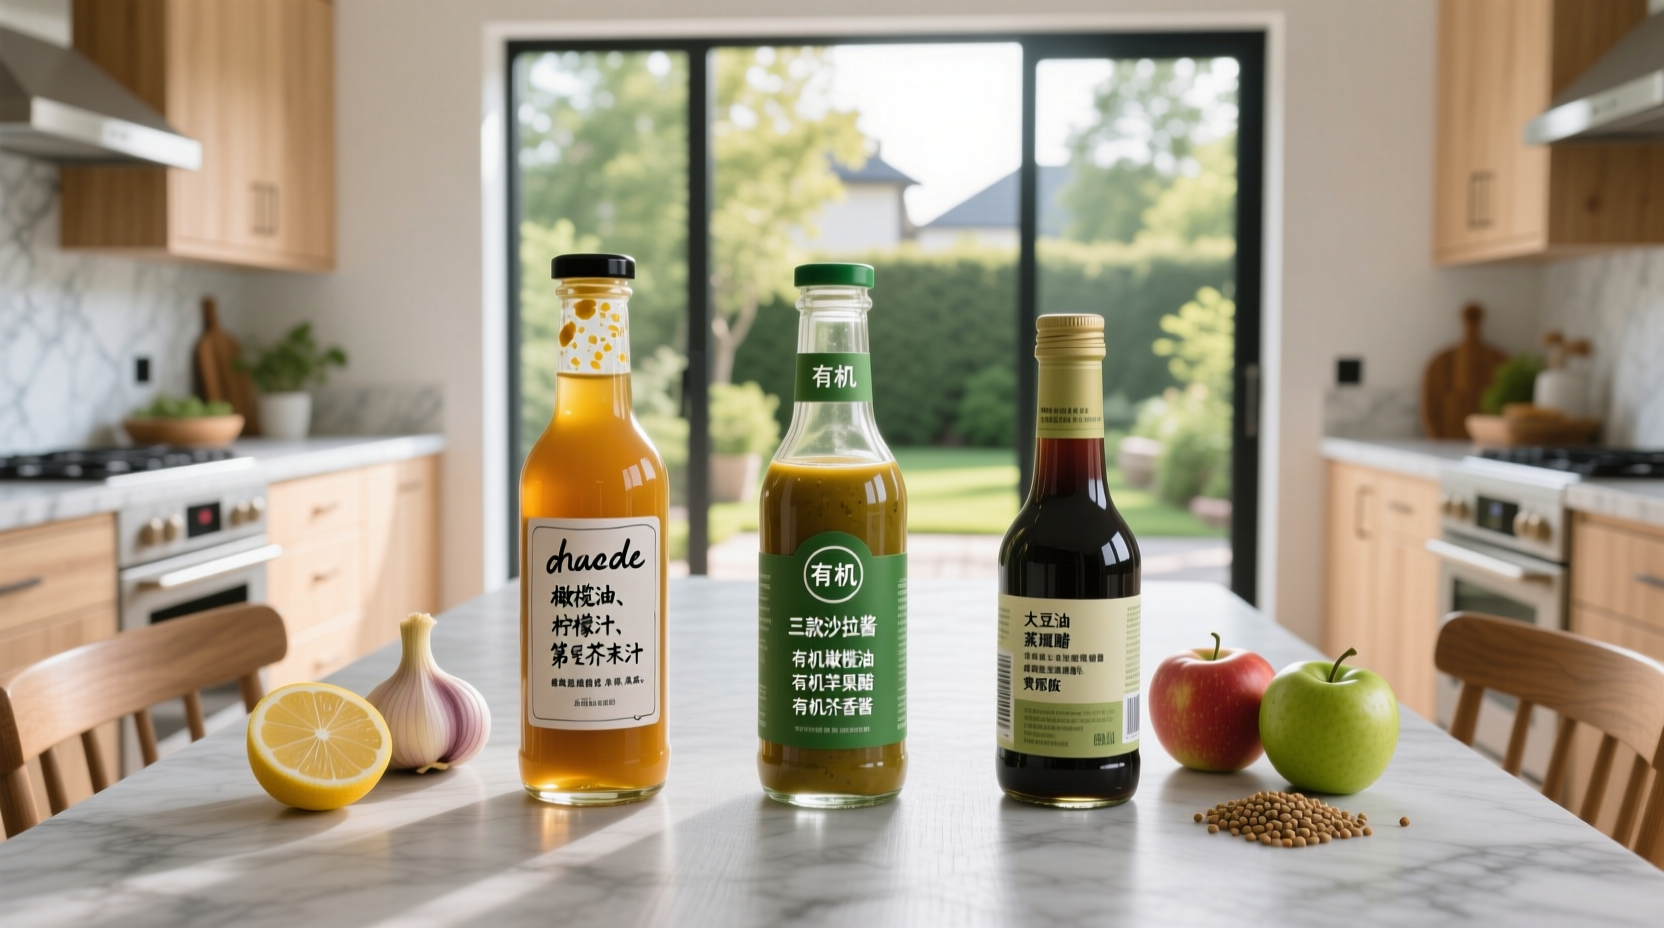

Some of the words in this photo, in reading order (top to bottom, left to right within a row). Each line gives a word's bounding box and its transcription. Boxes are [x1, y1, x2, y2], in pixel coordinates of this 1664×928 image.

[812, 364, 857, 388] 有机
[810, 562, 858, 587] 有机
[788, 614, 877, 638] 三款沙拉酱
[1024, 610, 1070, 628] 大豆油
